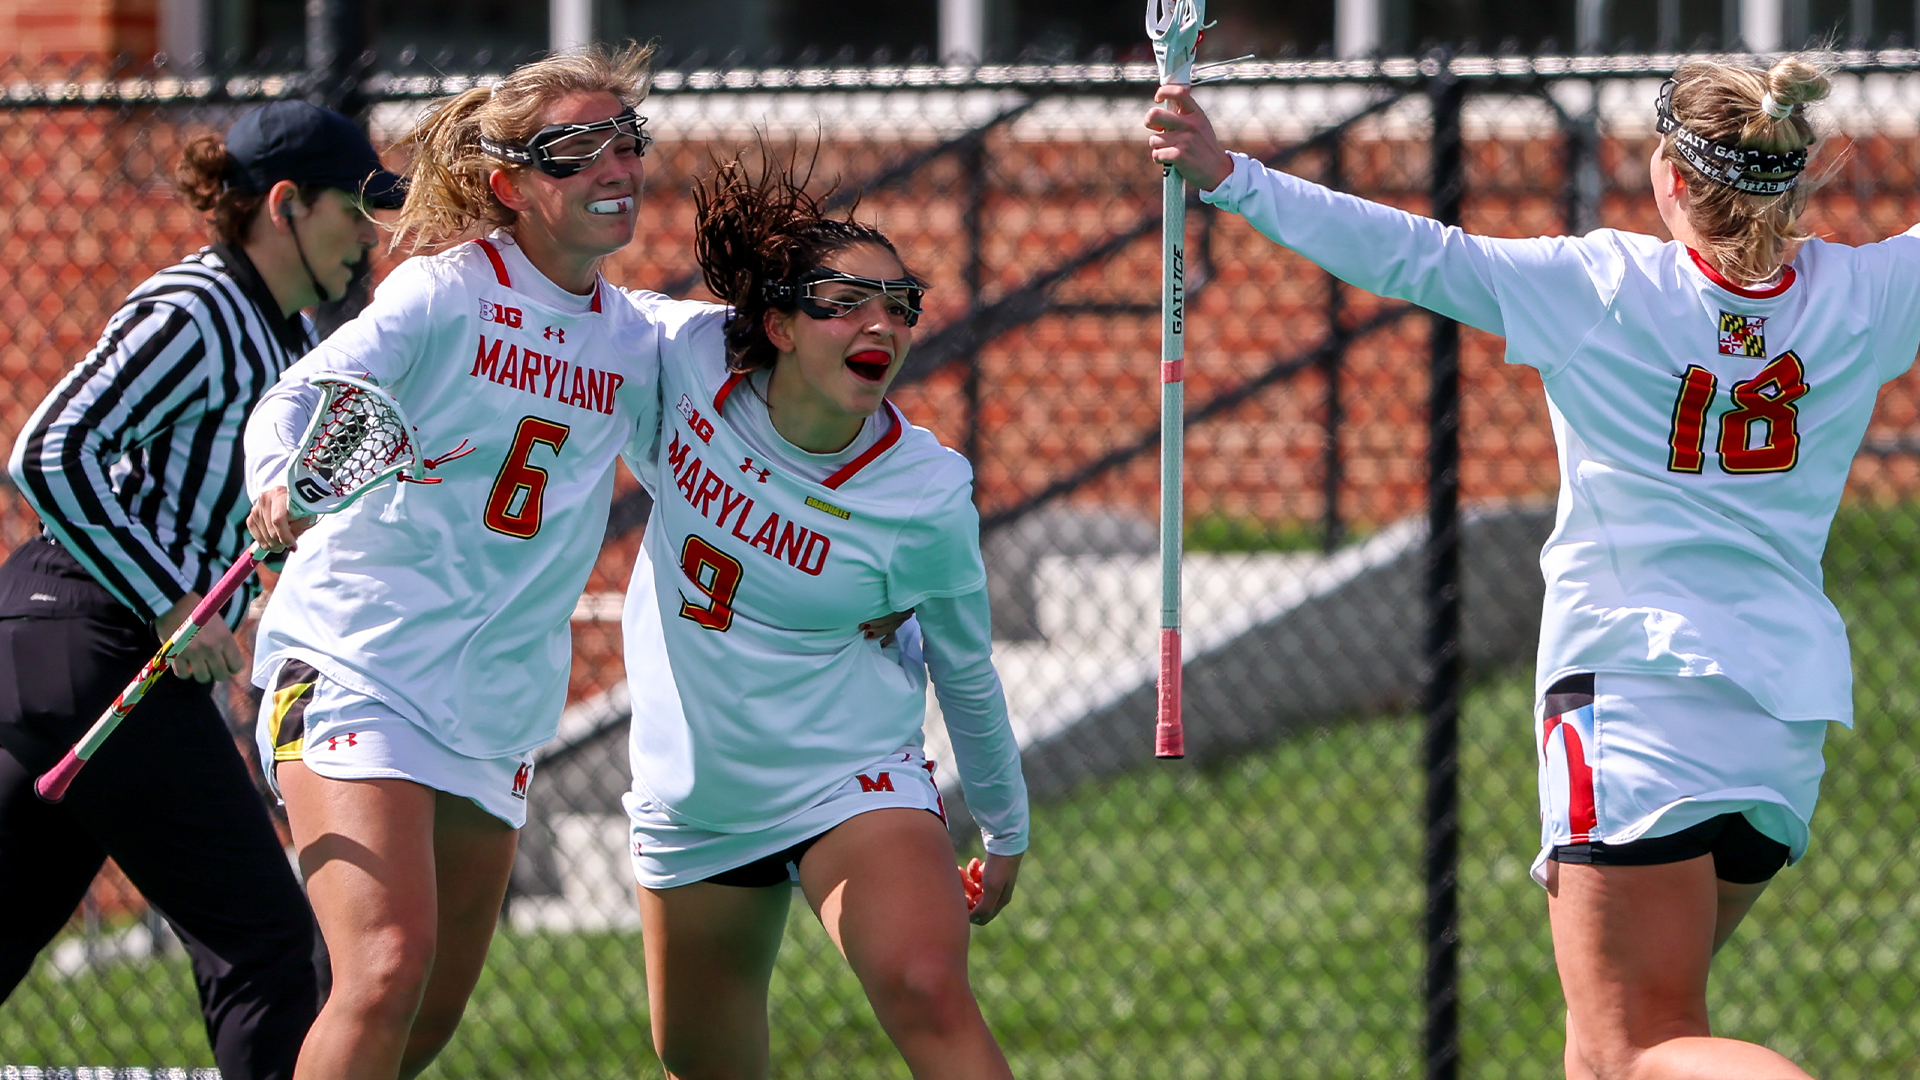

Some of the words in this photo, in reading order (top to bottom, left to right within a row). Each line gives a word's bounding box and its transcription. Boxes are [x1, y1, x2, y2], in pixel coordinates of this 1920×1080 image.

[1677, 128, 1709, 150] GAIT
[469, 334, 625, 416] MARYLAND
[1667, 349, 1811, 475] 18
[483, 415, 571, 540] 6
[668, 428, 831, 577] MARYLAND
[805, 496, 850, 520] GRADUATE
[678, 533, 744, 632] 9
[511, 761, 532, 796] M
[855, 772, 895, 793] M
